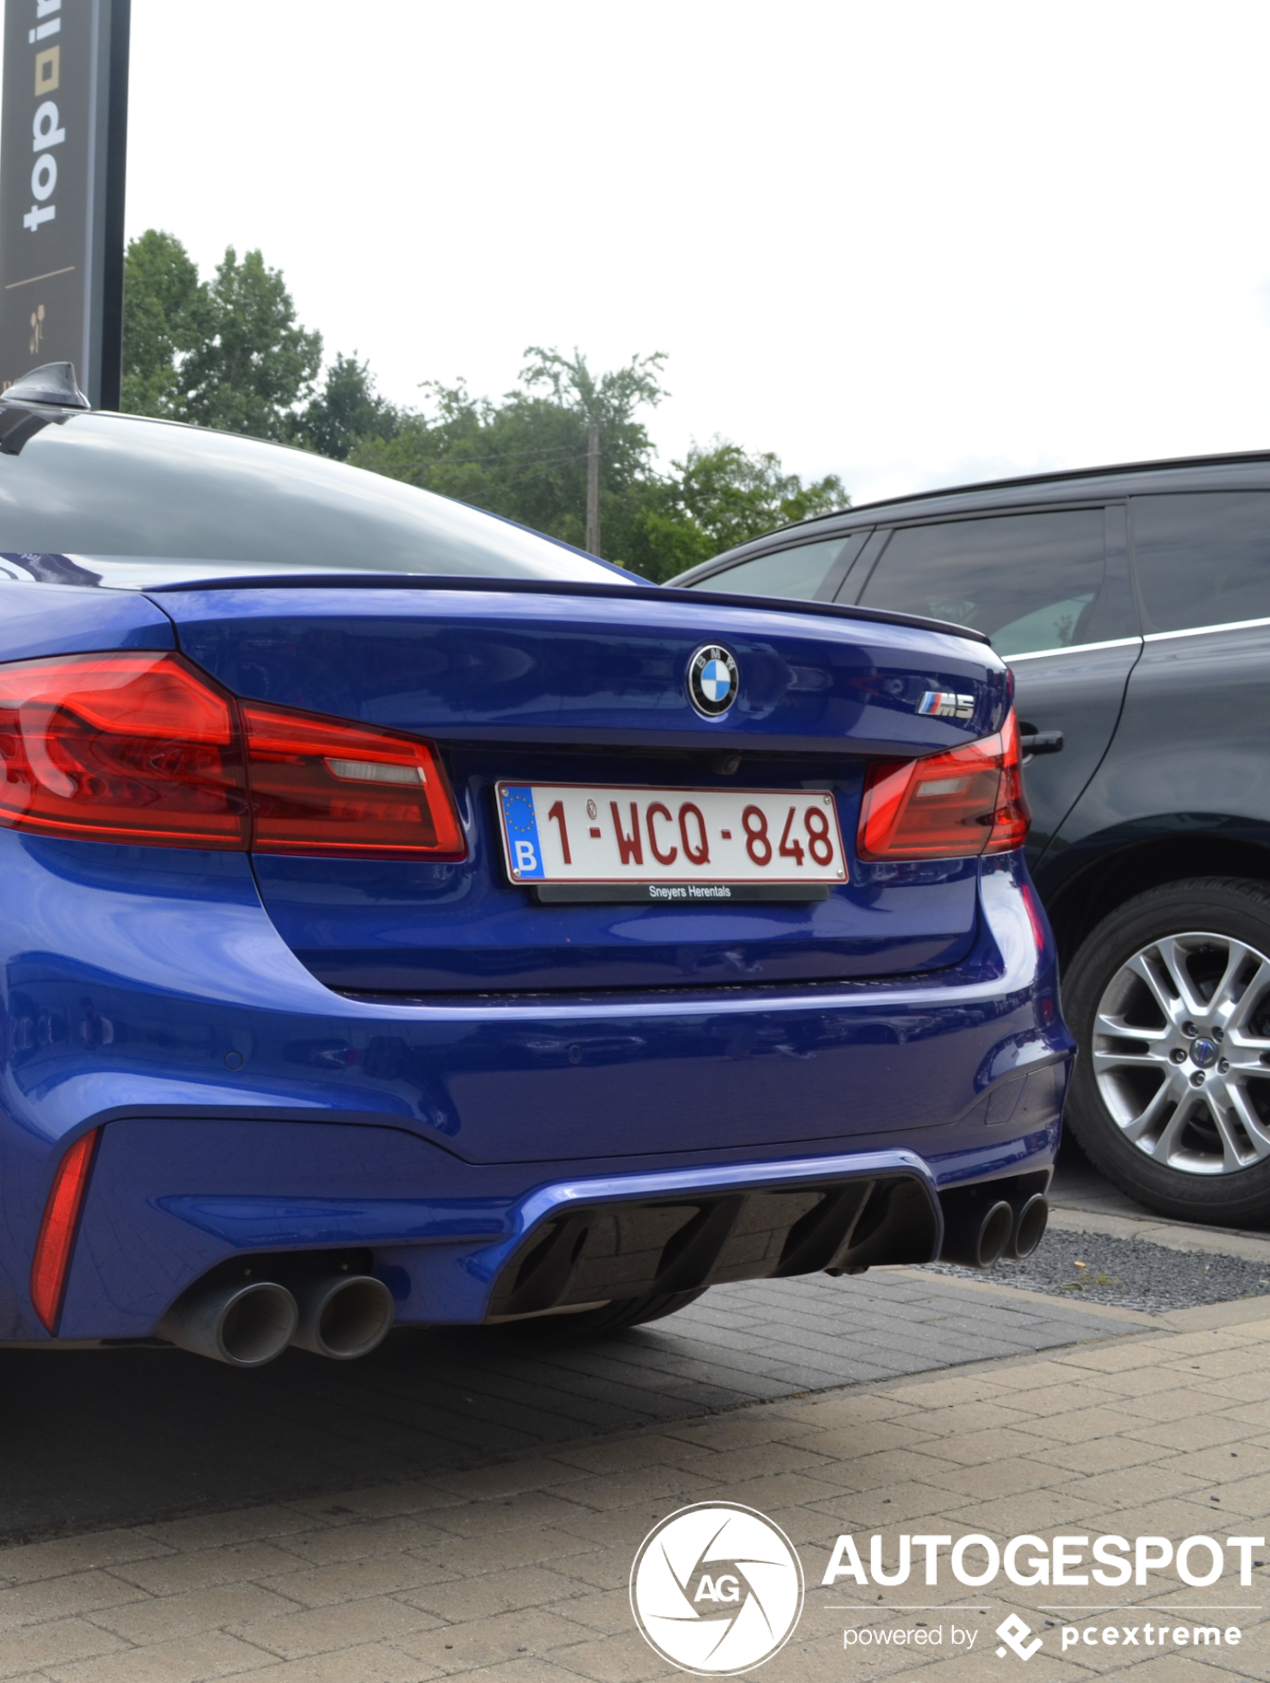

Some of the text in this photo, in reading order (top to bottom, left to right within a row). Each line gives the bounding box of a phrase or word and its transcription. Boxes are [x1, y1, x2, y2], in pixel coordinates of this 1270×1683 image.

[695, 648, 736, 671] BMW
[918, 691, 974, 719] M5
[548, 800, 834, 867] 1-WCQ-848
[514, 840, 538, 872] B
[648, 885, 732, 900] Sneyers Herentals
